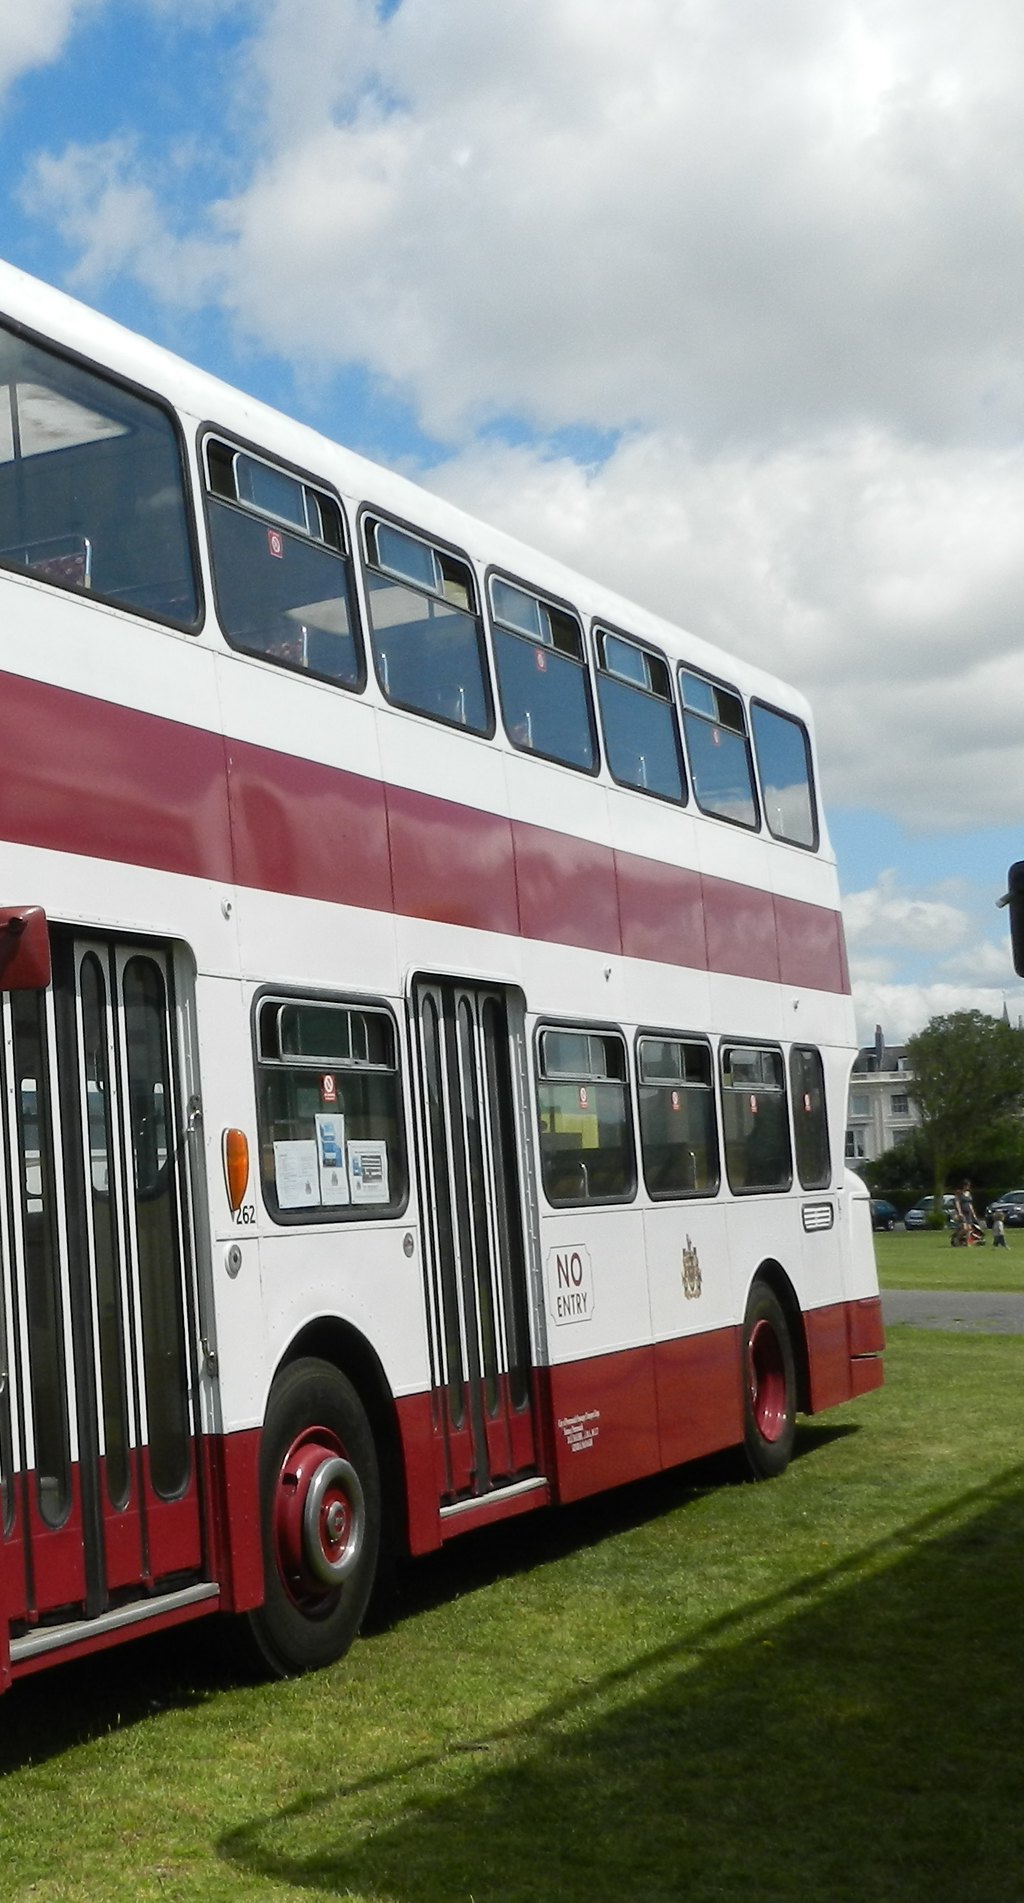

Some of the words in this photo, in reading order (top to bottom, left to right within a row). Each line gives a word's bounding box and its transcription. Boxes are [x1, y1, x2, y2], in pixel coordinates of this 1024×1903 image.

[236, 1205, 256, 1225] 262
[556, 1252, 583, 1289] NO
[557, 1292, 588, 1317] ENTRY
